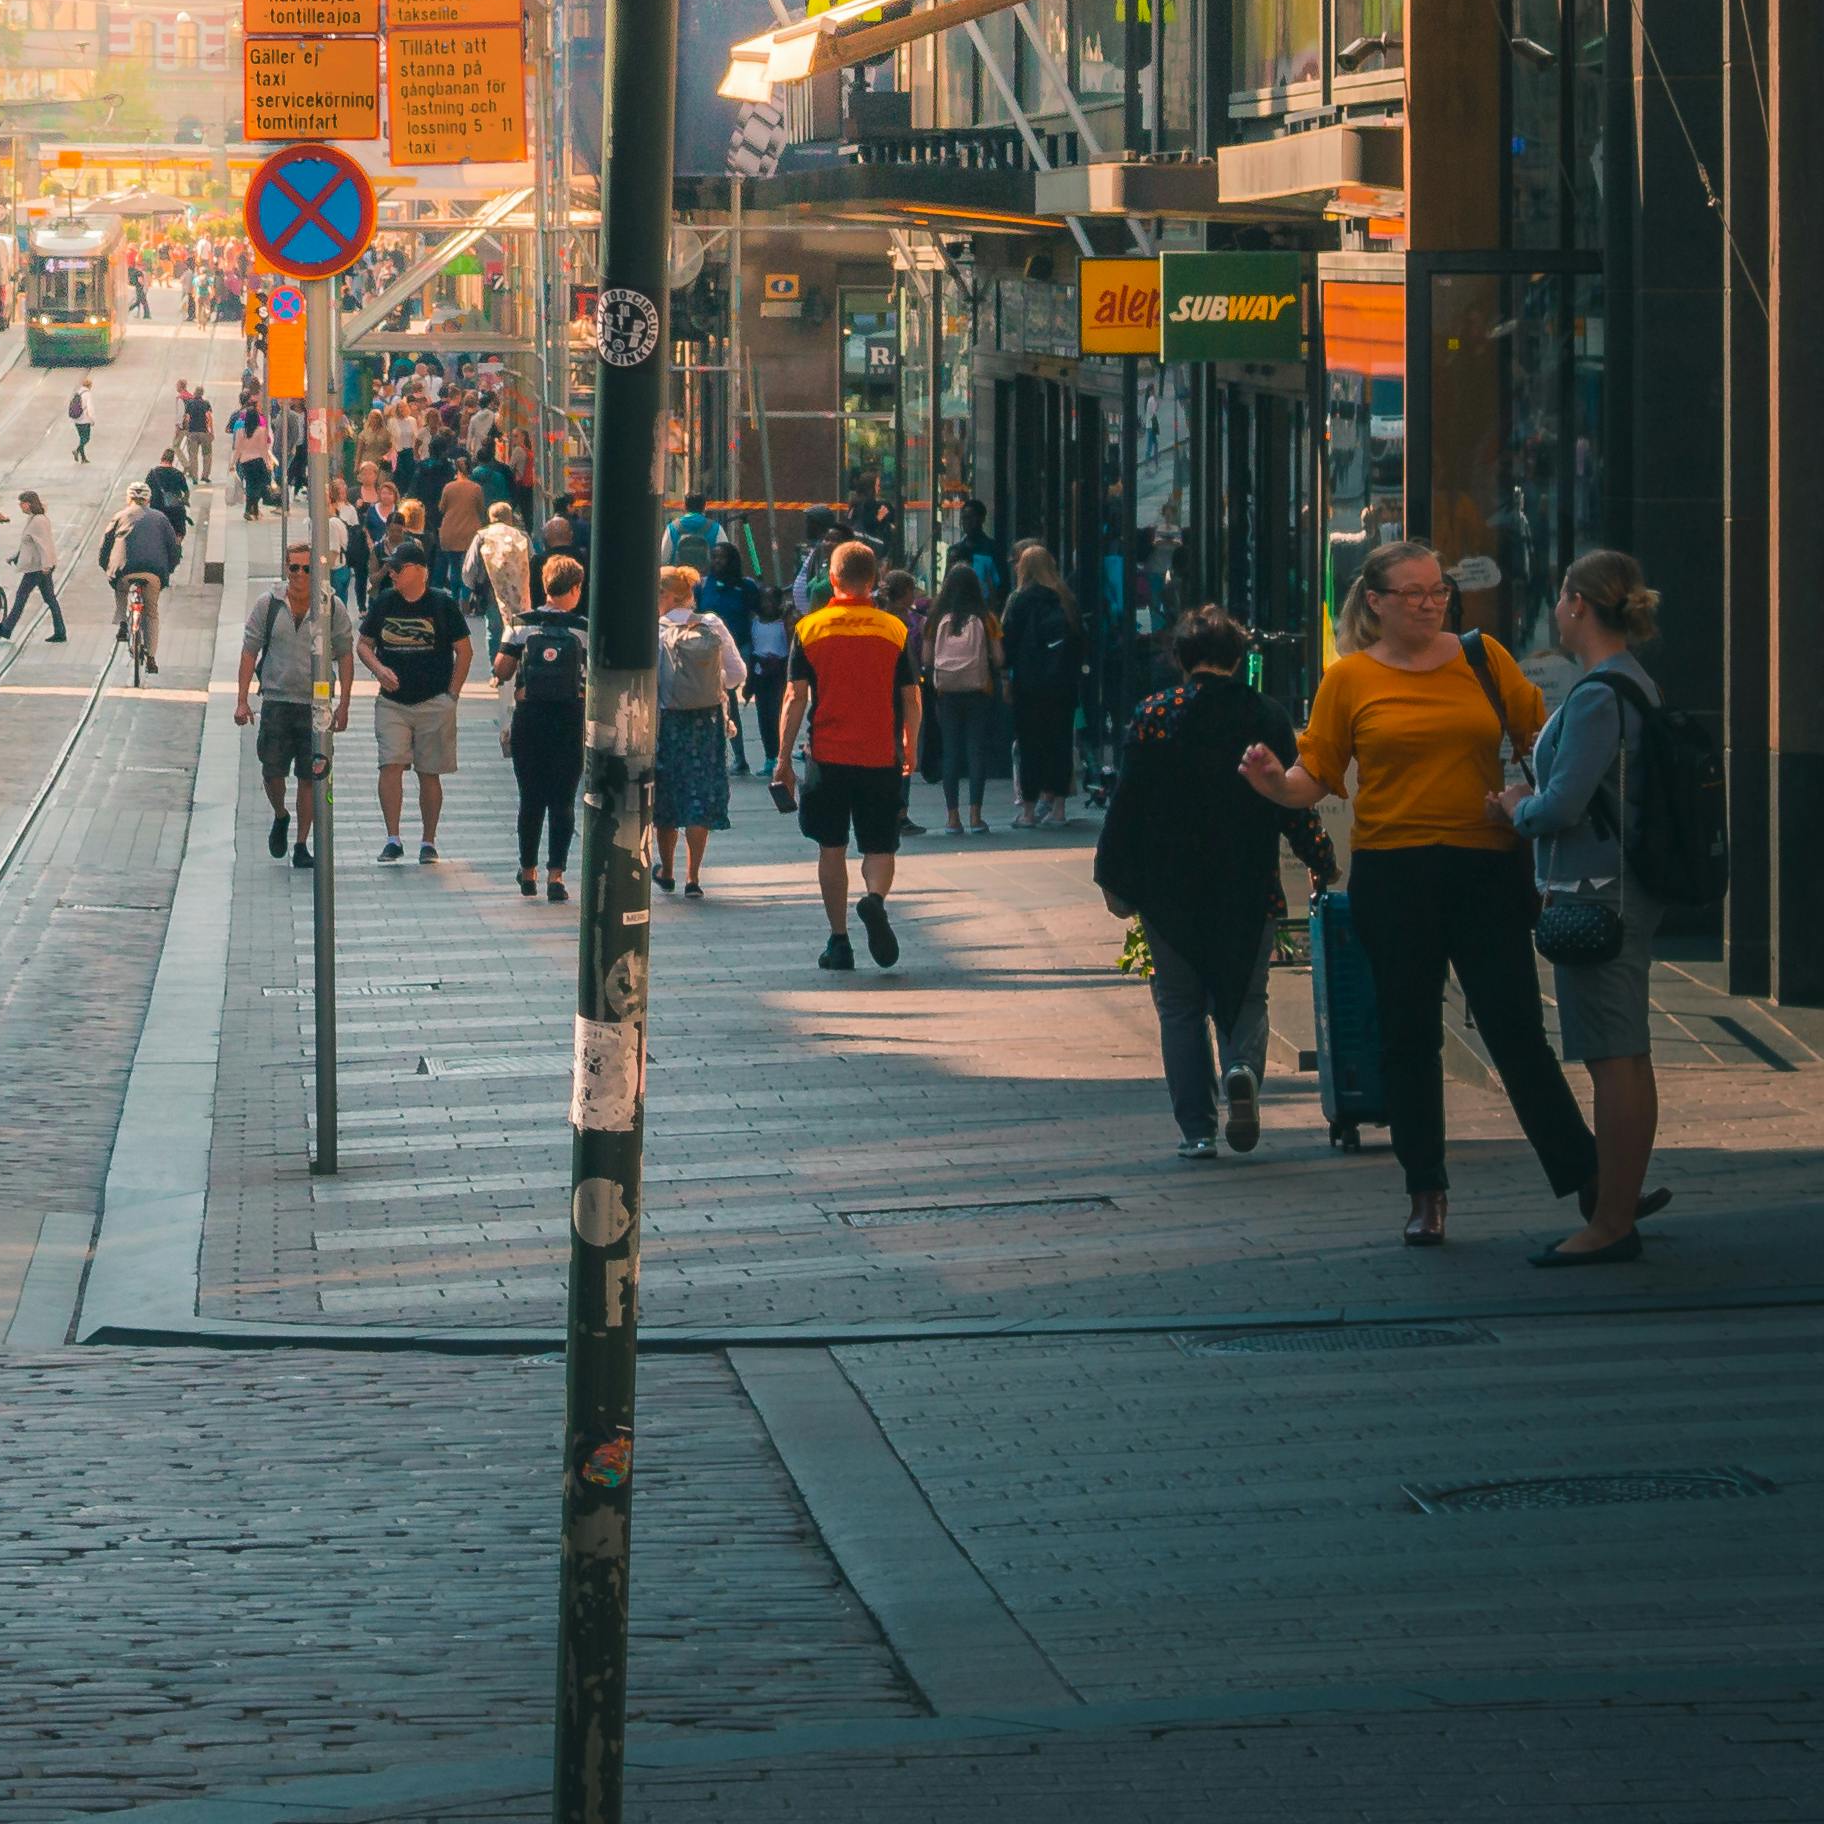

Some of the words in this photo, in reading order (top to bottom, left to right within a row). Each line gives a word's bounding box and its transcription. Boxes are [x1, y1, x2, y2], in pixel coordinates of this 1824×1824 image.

[400, 38, 456, 56] Tillåtet
[465, 37, 486, 54] att
[250, 48, 295, 64] Gäller
[304, 47, 319, 67] ej
[400, 61, 455, 77] stanna
[463, 59, 482, 78] på
[400, 81, 479, 98] gångbanan
[487, 80, 506, 94] för
[471, 99, 497, 113] och
[408, 120, 466, 136] lossning
[474, 119, 483, 133] 5
[1169, 293, 1296, 323] SUBWAY
